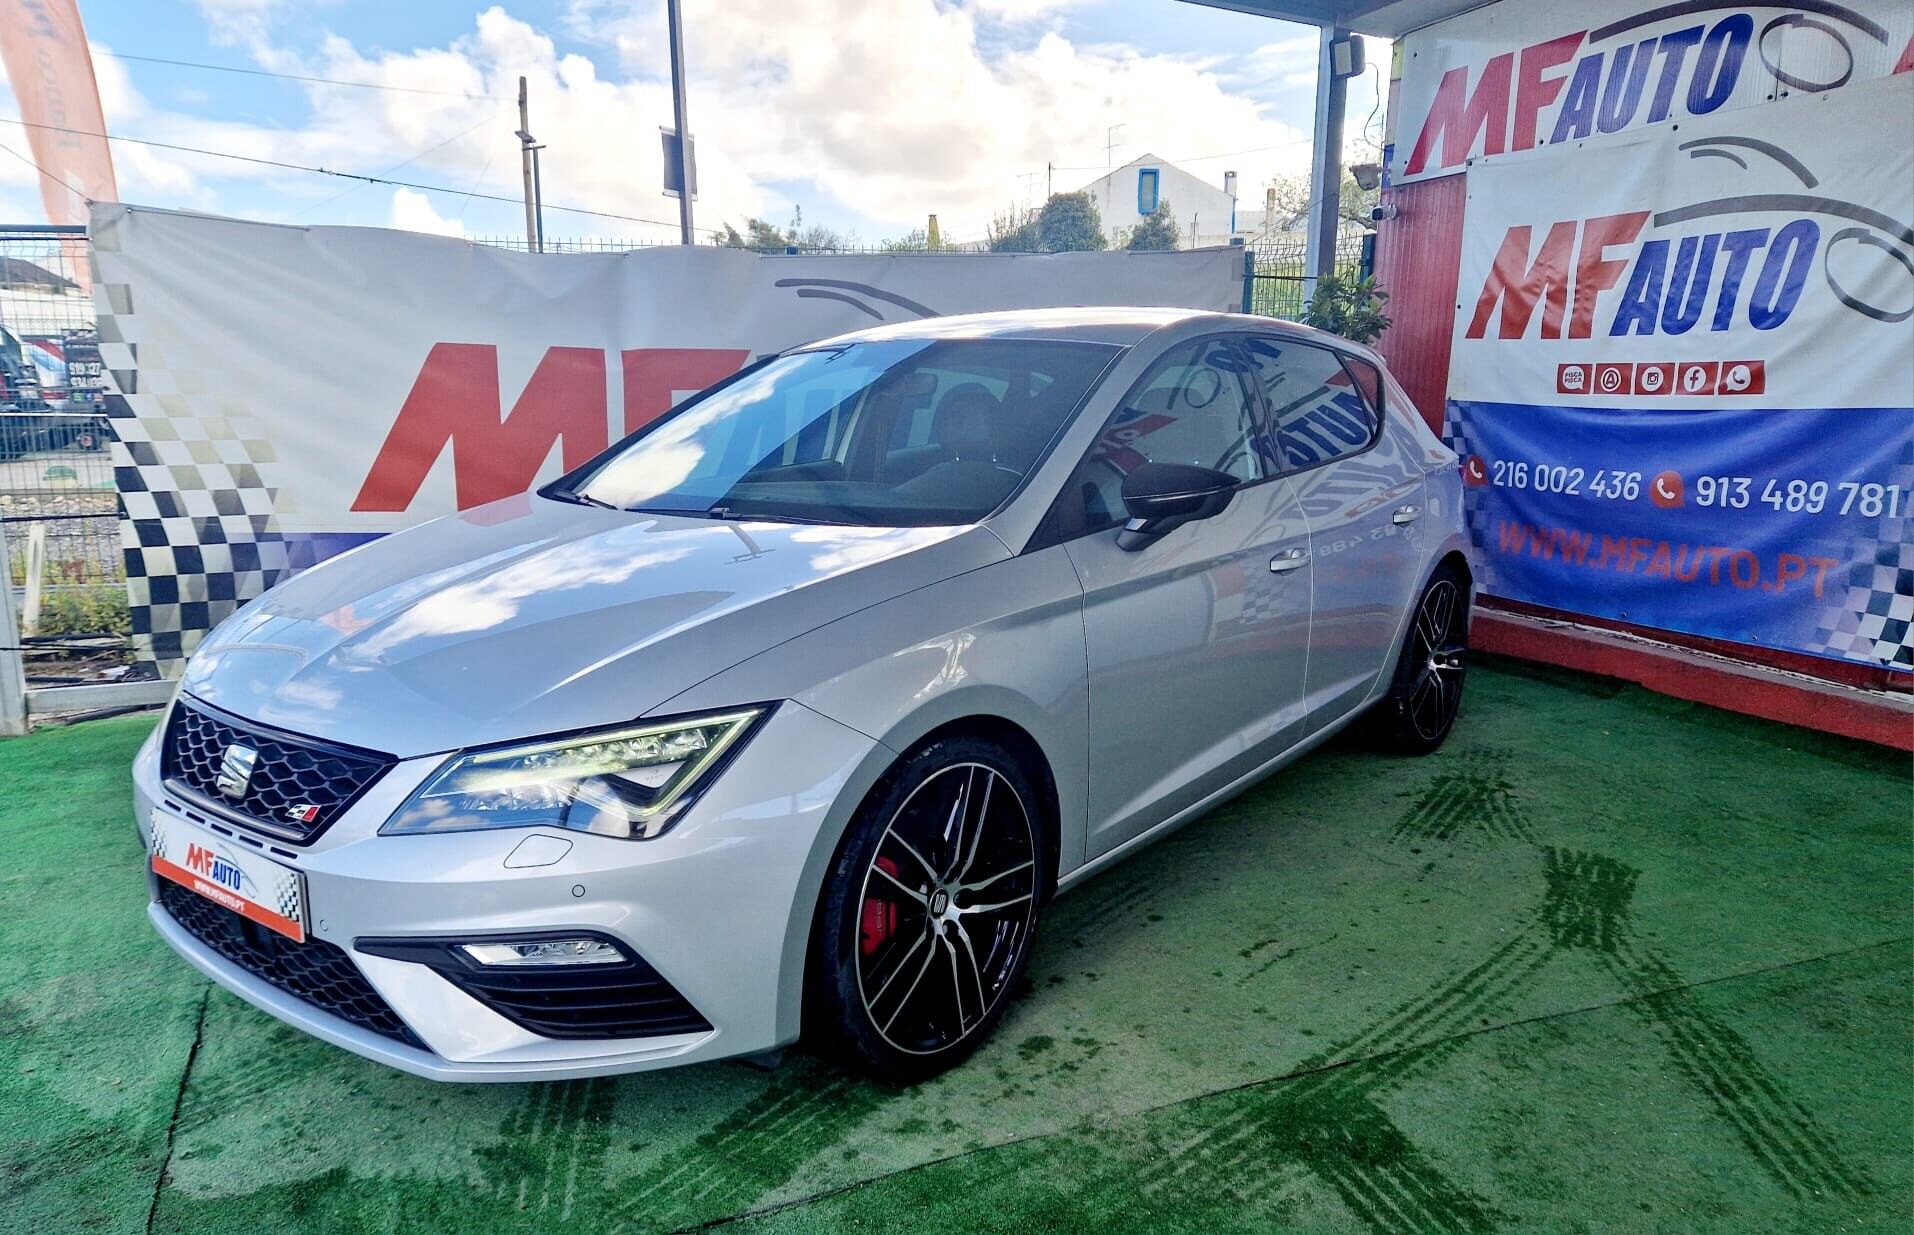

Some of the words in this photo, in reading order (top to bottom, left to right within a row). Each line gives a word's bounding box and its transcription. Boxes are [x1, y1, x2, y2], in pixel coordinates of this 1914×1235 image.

[1493, 460, 1528, 490] 216
[1534, 464, 1584, 497] 002
[1588, 470, 1642, 502] 436
[1696, 475, 1750, 509] 913
[1760, 478, 1827, 513] 489
[1838, 482, 1901, 519] 781
[1498, 519, 1839, 600] WWW.MFAUTO.PT
